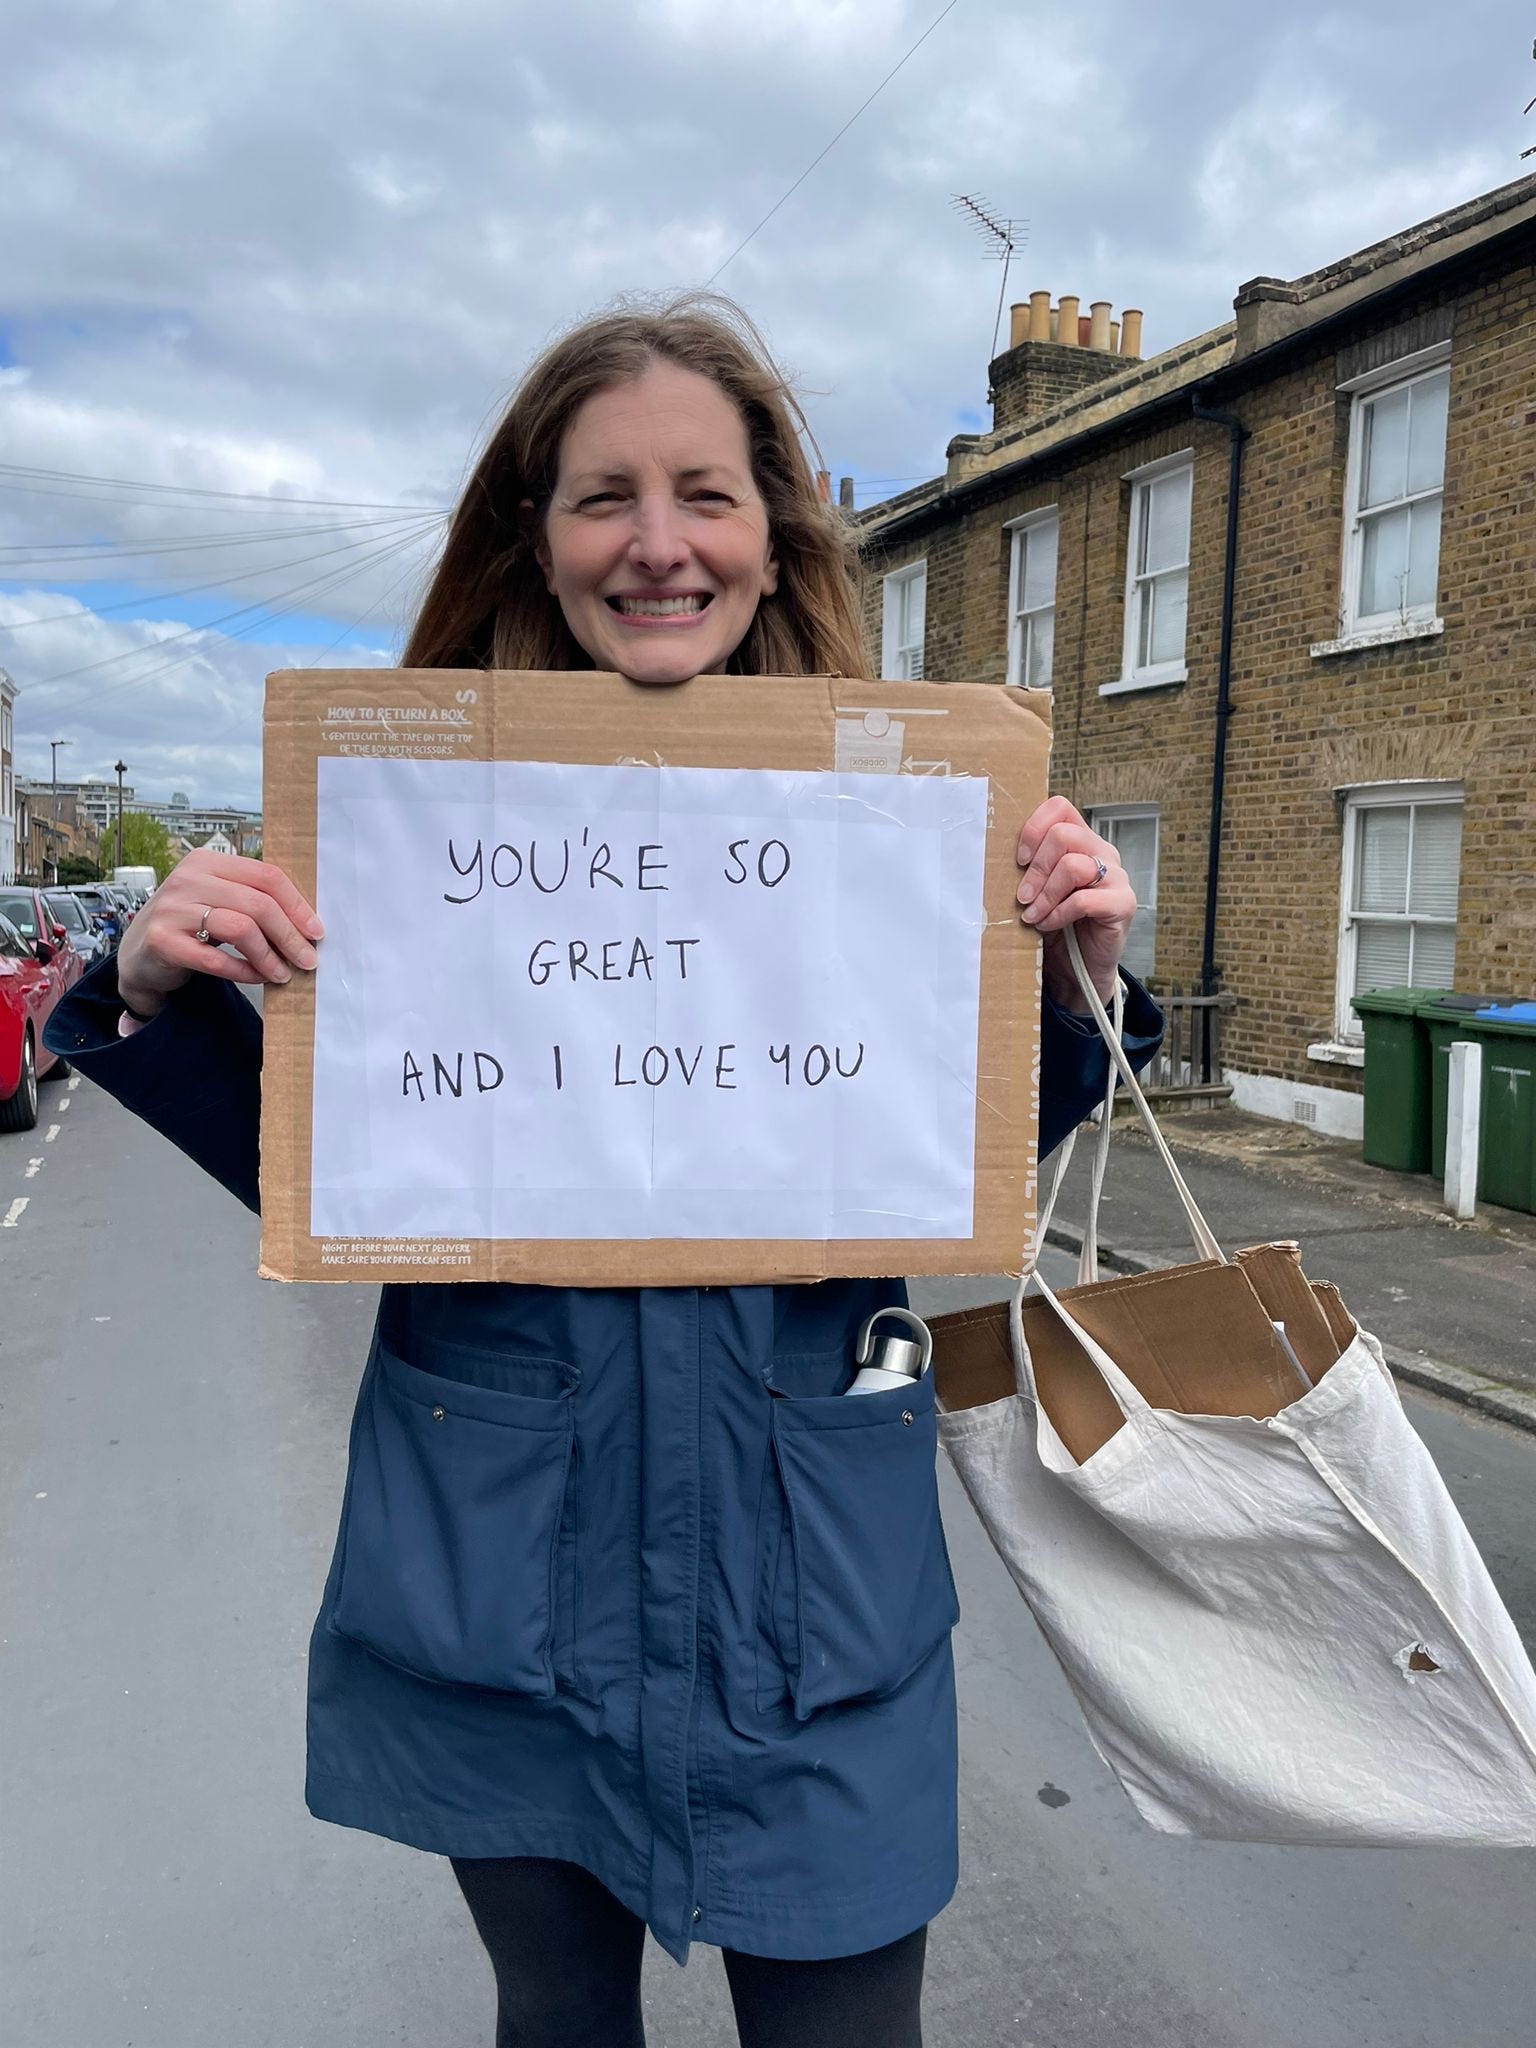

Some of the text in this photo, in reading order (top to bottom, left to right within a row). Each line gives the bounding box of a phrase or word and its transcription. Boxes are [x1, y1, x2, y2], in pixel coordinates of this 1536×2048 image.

[327, 706, 356, 720] HOW
[358, 707, 374, 720] TO
[377, 706, 427, 720] RETURN
[429, 708, 439, 720] A
[328, 731, 360, 741] GENTLY
[361, 732, 379, 741] CUT
[381, 732, 399, 742] THE
[401, 733, 422, 742] TAPE
[423, 733, 435, 742] ON
[437, 733, 455, 743] THE
[457, 734, 473, 743] TOP
[339, 744, 456, 755] OF THE BOX WITH SCISSORS.
[444, 827, 791, 904] YOU'RE SO
[528, 936, 700, 986] GREAT
[402, 1041, 865, 1101] AND I LOVE YOU
[321, 1243, 350, 1253] NIGHT
[351, 1243, 381, 1253] BEFORE
[383, 1243, 405, 1253] YOUR
[405, 1243, 431, 1253] NEXT
[321, 1255, 345, 1265] MAKE
[346, 1255, 369, 1265] SURE
[370, 1255, 392, 1265] YOUR
[392, 1255, 421, 1265] DRIVER
[422, 1255, 440, 1265] CAN
[440, 1255, 457, 1265] SEE
